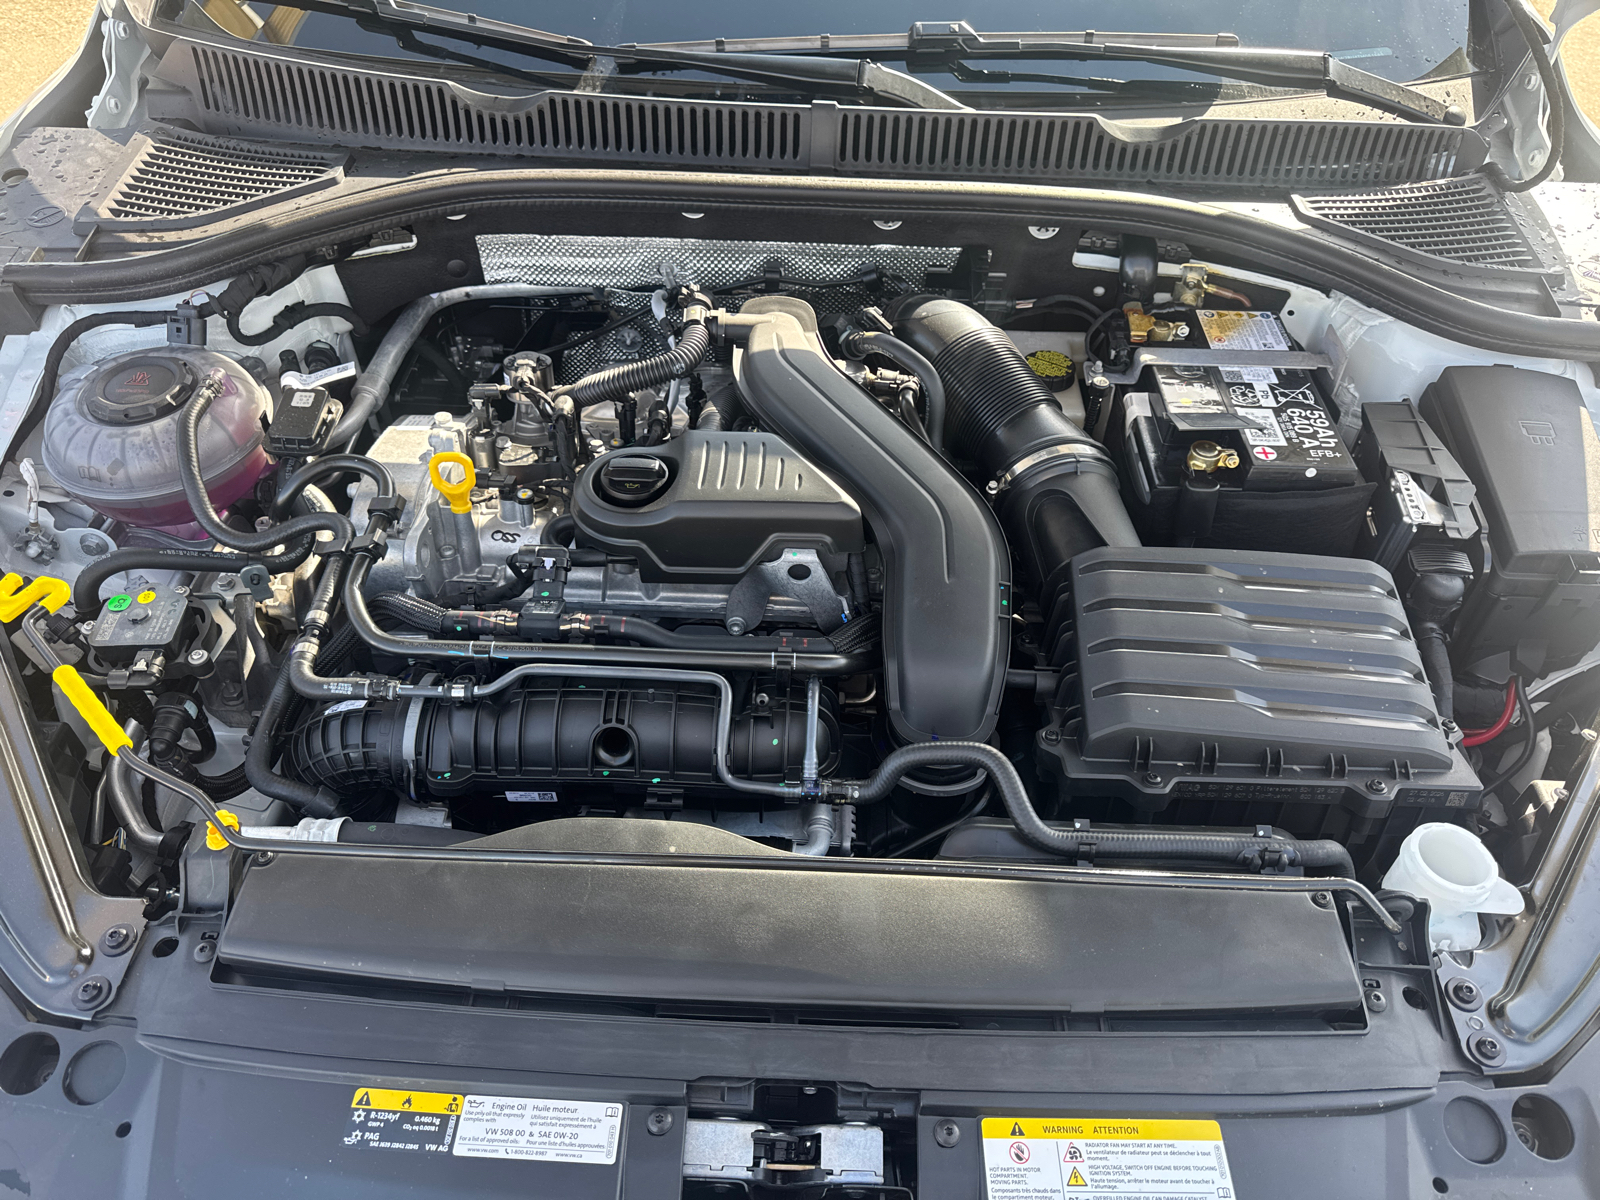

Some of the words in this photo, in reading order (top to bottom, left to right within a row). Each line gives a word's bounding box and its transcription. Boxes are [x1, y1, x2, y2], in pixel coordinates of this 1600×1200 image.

[1258, 390, 1270, 400] Pb
[1286, 408, 1314, 434] 640
[1306, 410, 1338, 448] 59Ah
[1298, 436, 1320, 448] A
[1310, 450, 1342, 458] EFB+
[492, 1103, 515, 1111] Engine
[370, 1111, 400, 1122] R-1234yf
[433, 1116, 441, 1125] kg
[1042, 1126, 1084, 1134] WARNING
[1093, 1126, 1139, 1134] ATTENTION
[364, 1132, 380, 1140] PAG
[553, 1131, 579, 1140] 0W-20
